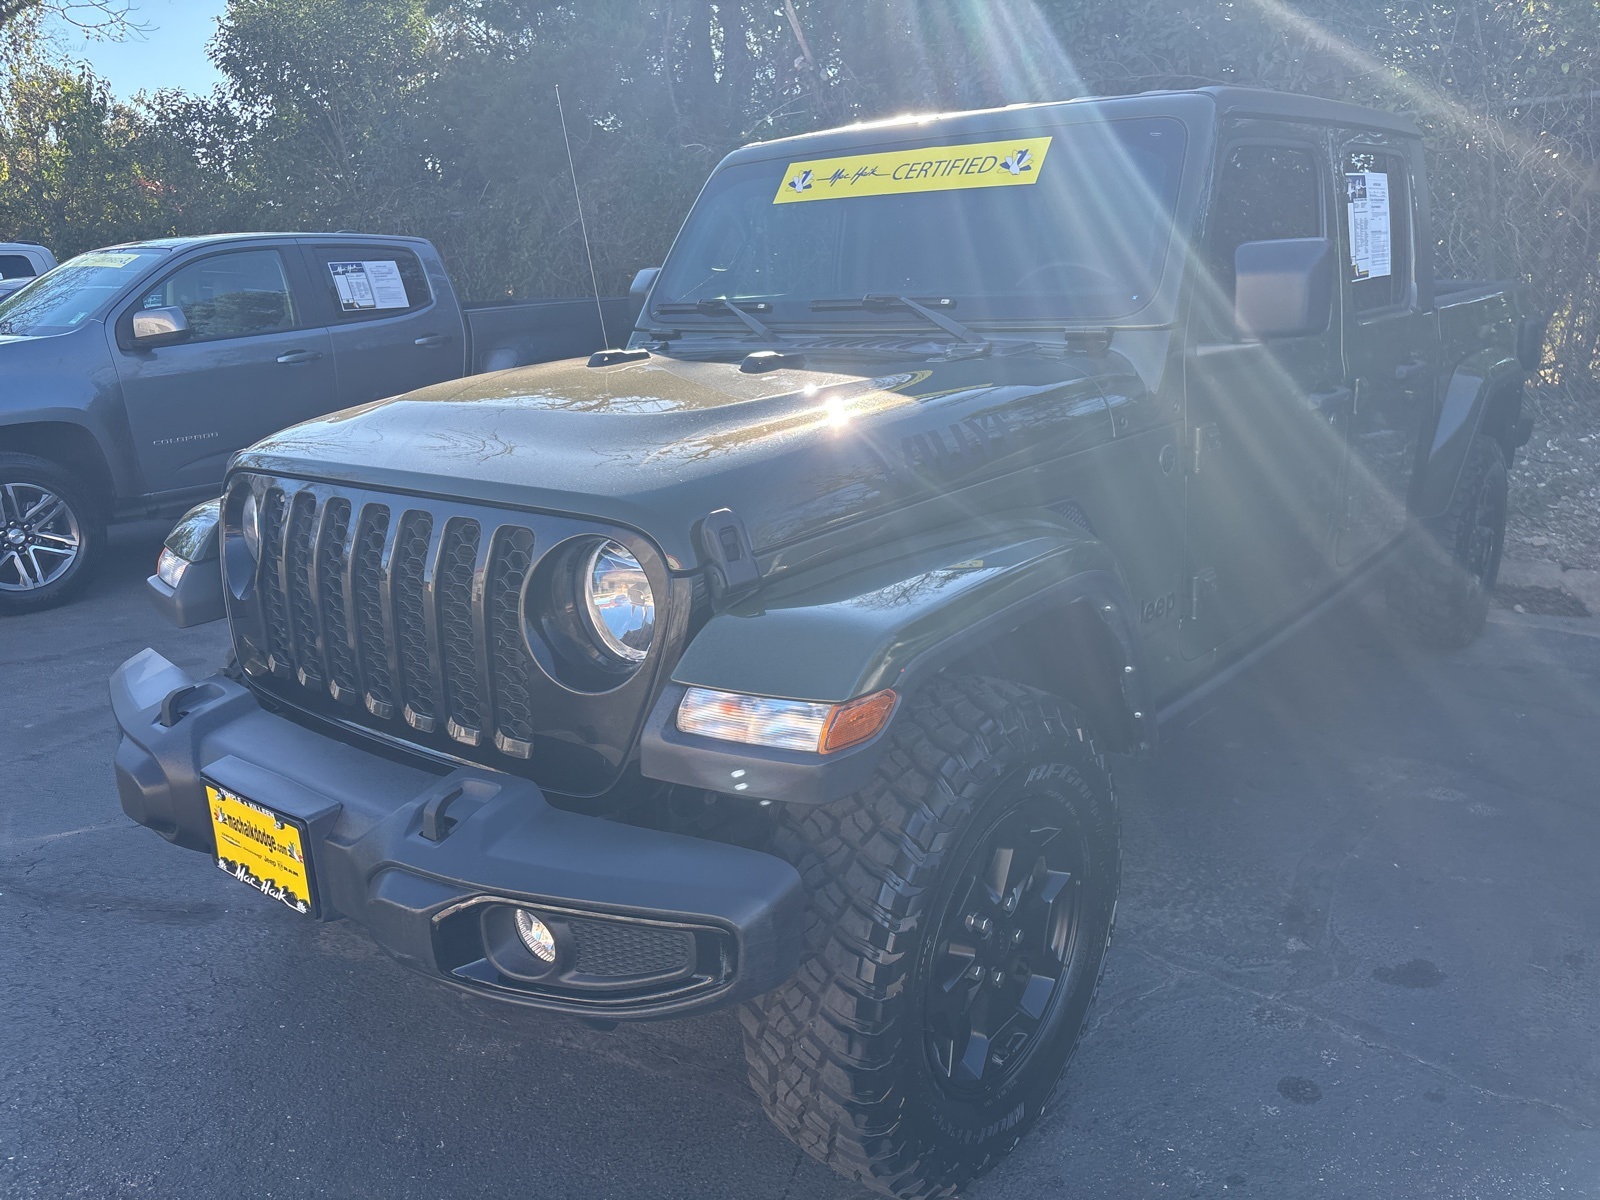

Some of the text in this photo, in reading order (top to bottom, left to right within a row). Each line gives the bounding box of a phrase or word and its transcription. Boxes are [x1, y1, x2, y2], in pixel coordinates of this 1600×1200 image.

[892, 155, 998, 181] CERTIFIED
[152, 431, 219, 446] COLORADO
[227, 814, 288, 855] machaikdodge.com
[234, 866, 289, 903] Mac Haik
